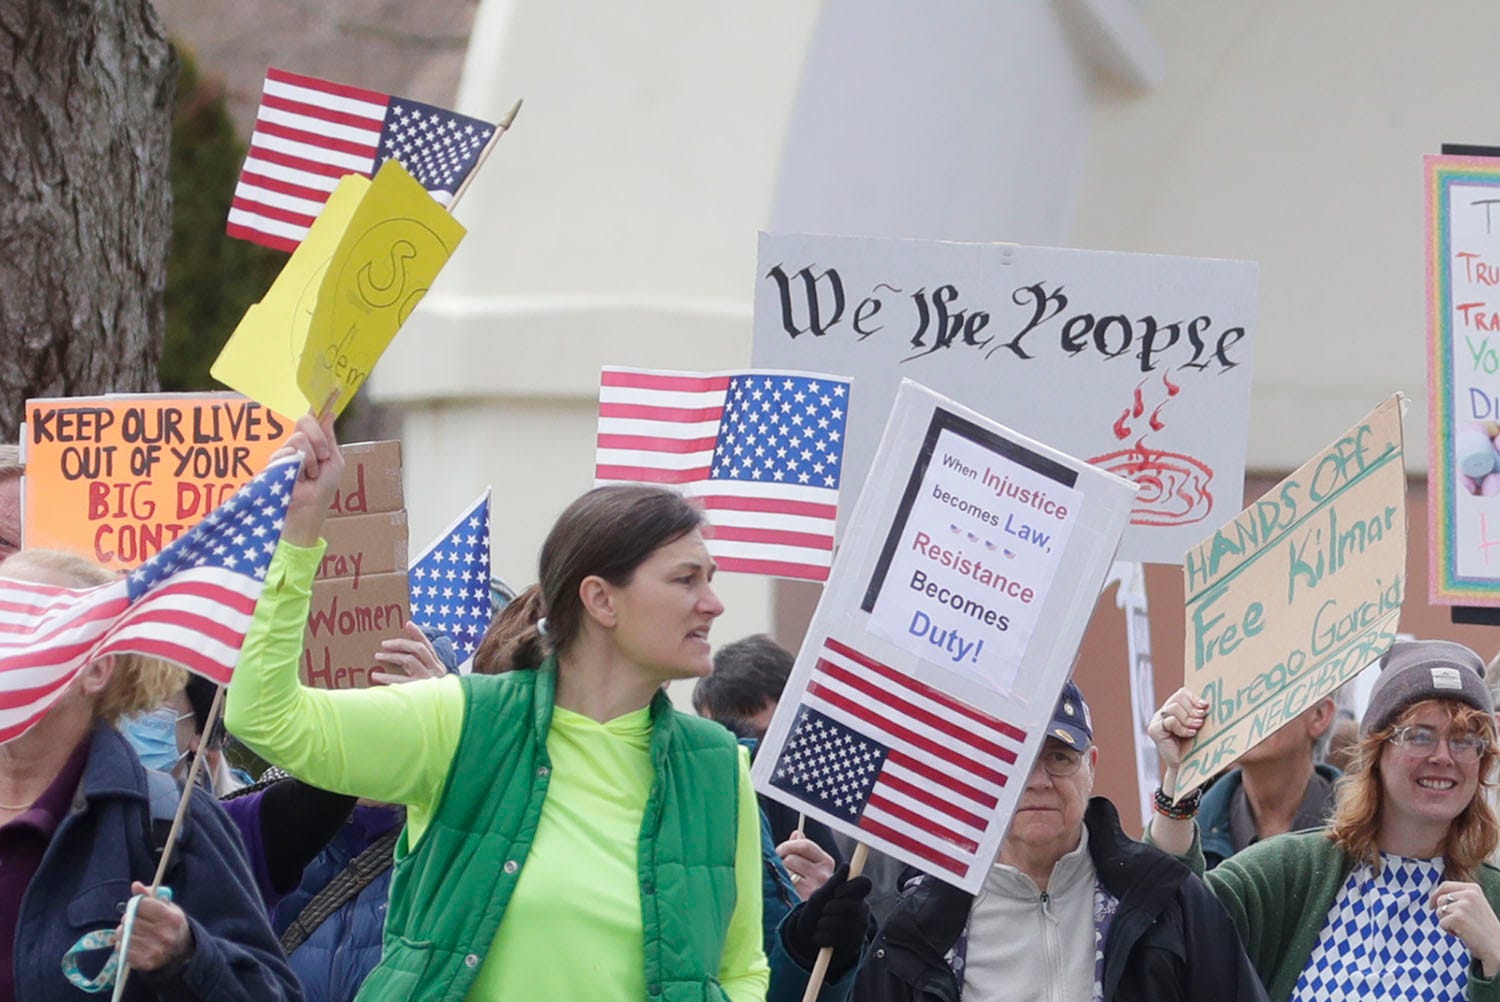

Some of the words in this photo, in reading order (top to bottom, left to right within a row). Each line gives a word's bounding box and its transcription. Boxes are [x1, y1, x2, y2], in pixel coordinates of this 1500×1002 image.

[766, 262, 888, 342] We
[900, 284, 996, 363] the
[986, 281, 1246, 372] People
[33, 408, 115, 444] KEEP
[122, 408, 185, 444] OUR
[193, 402, 284, 442] LIVES
[61, 446, 118, 480] OUT
[130, 445, 161, 478] OF
[171, 447, 253, 479] YOUR
[942, 453, 978, 480] When
[982, 467, 1068, 520] Injustice
[88, 481, 155, 520] BIG
[932, 484, 1000, 526] becomes
[1004, 513, 1051, 554] Law,
[94, 523, 194, 563] CONT
[912, 531, 1034, 604] Resistance
[1187, 480, 1300, 592] HANDS
[308, 596, 404, 638] Women
[910, 569, 1010, 632] Becomes
[1192, 584, 1265, 672] Free
[1288, 506, 1397, 604] Kilmar
[908, 610, 984, 663] Duty!
[1201, 650, 1306, 728] Abrego
[1312, 574, 1400, 656] Garcia
[1175, 735, 1236, 793] OUR
